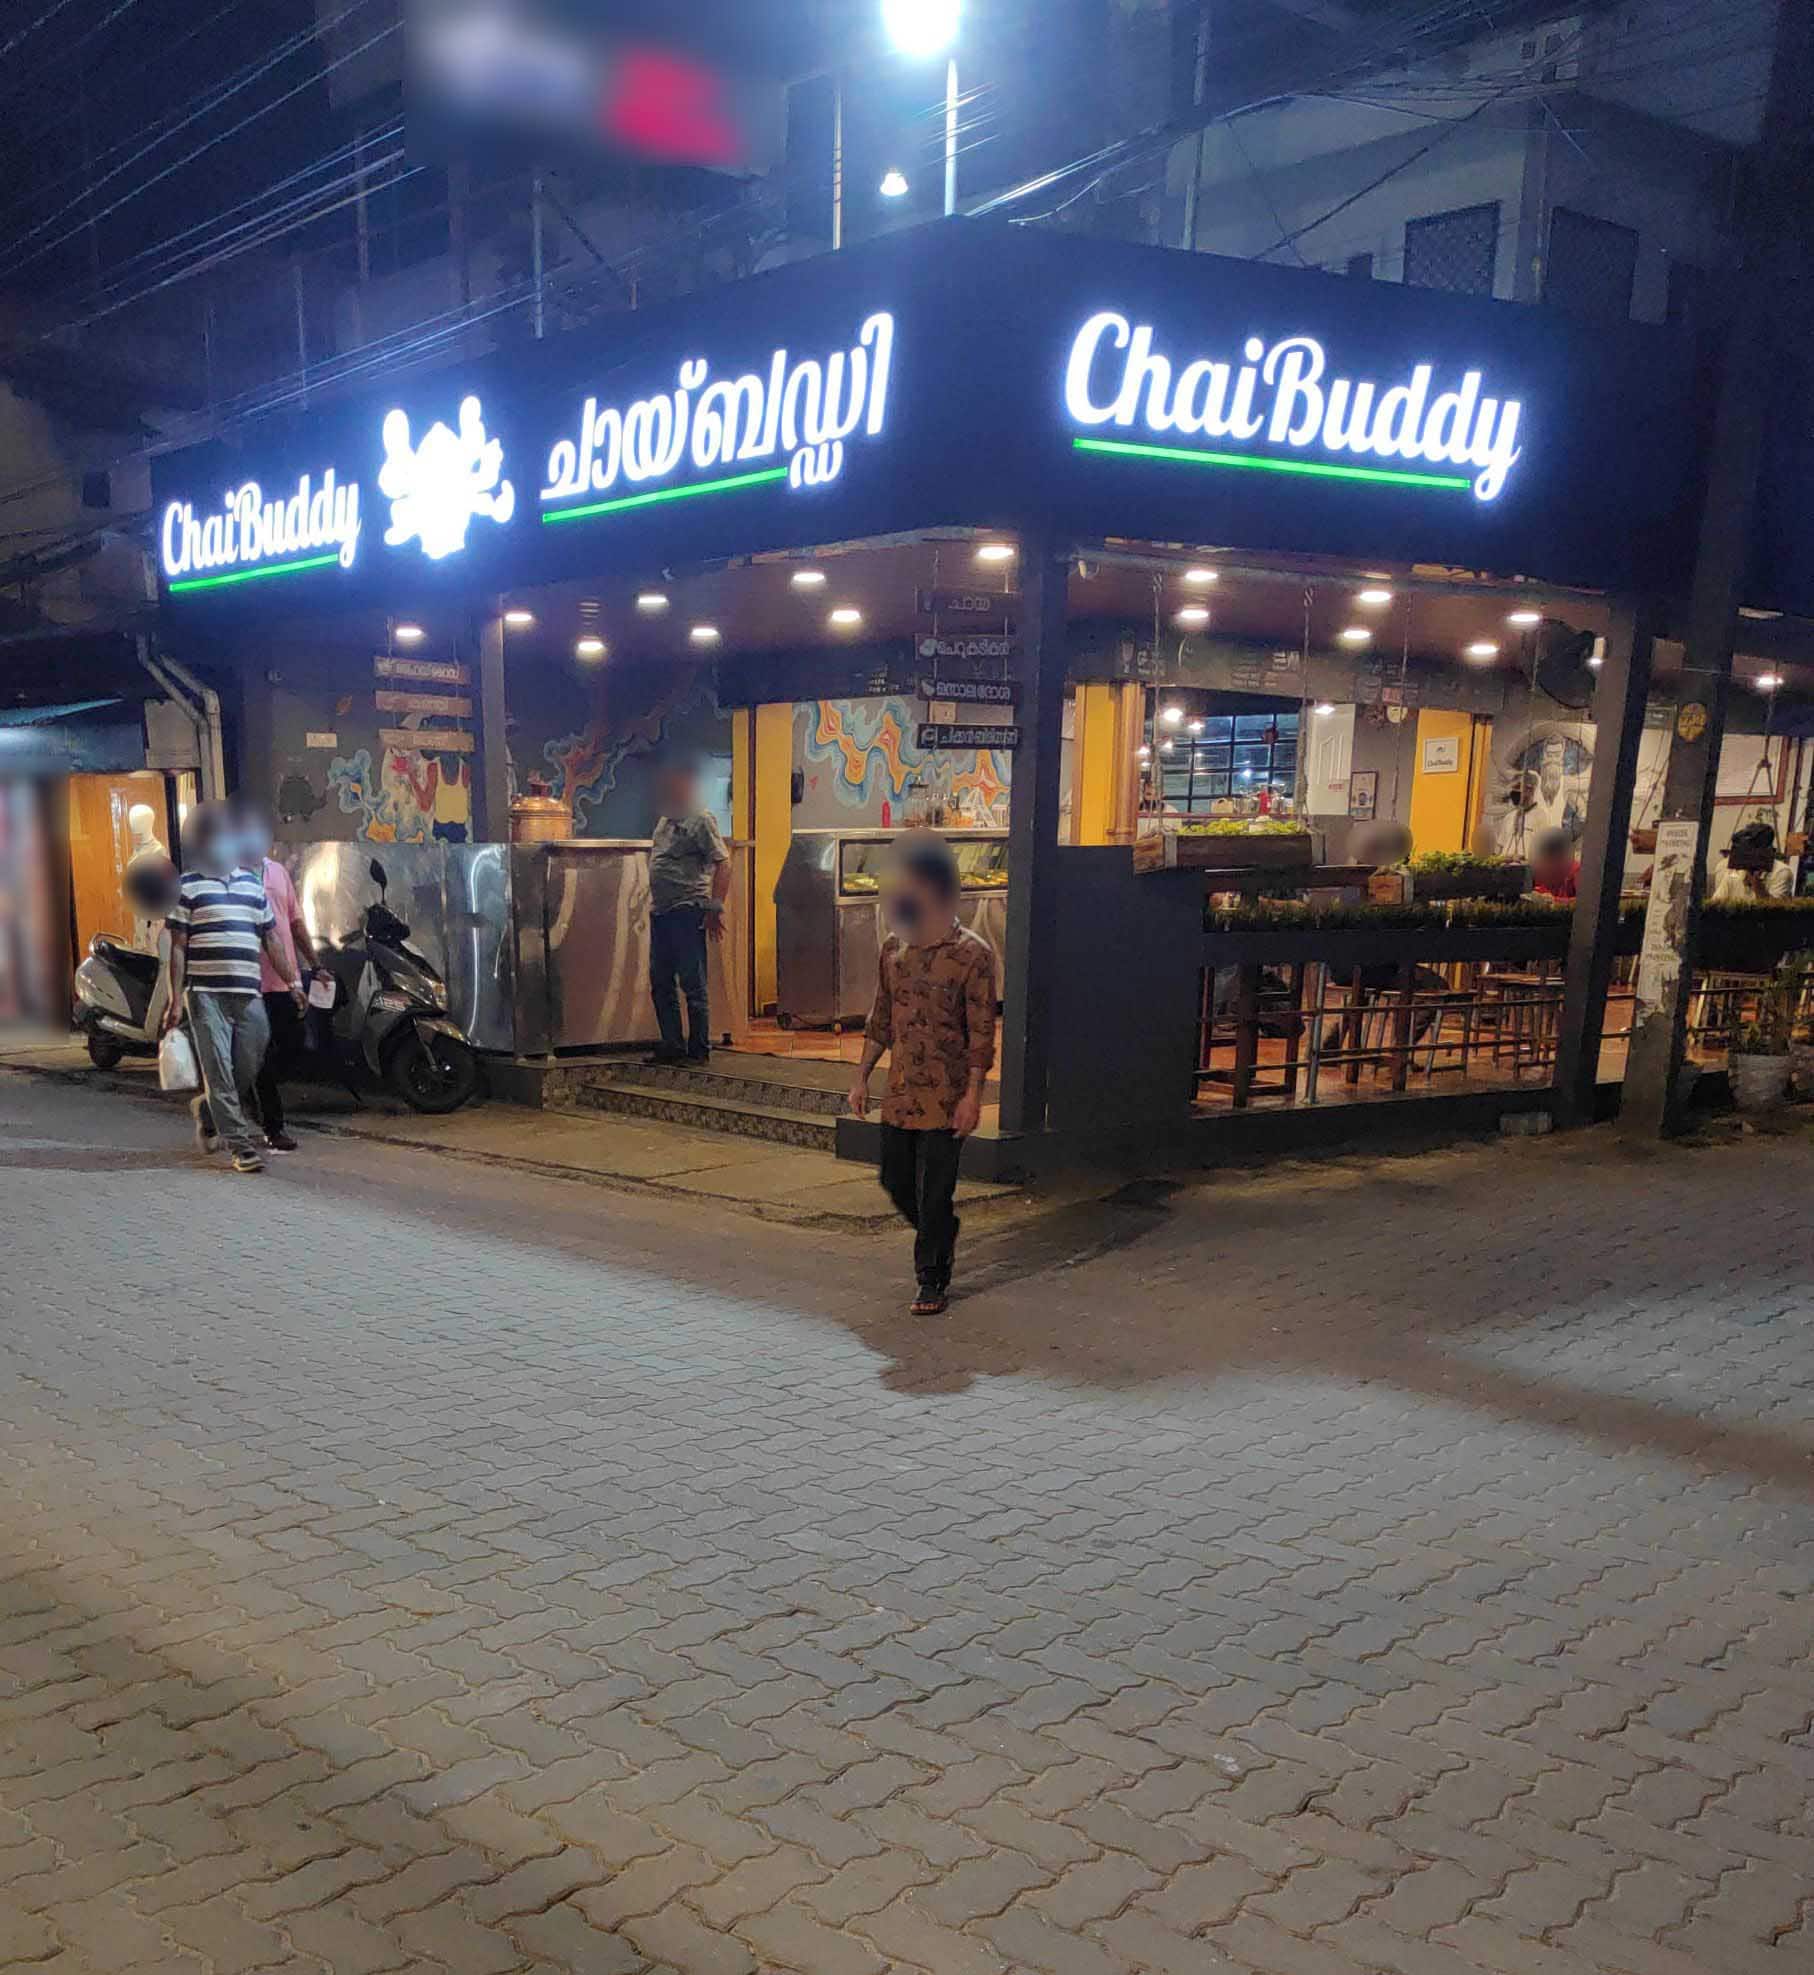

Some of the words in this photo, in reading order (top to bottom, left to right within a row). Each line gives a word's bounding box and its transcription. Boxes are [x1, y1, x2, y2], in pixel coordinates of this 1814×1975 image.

[541, 312, 893, 489] ചായ്ബഡ്ഡി
[1065, 311, 1522, 502] ChaiBuddy
[162, 467, 361, 575] ChaiBuddy
